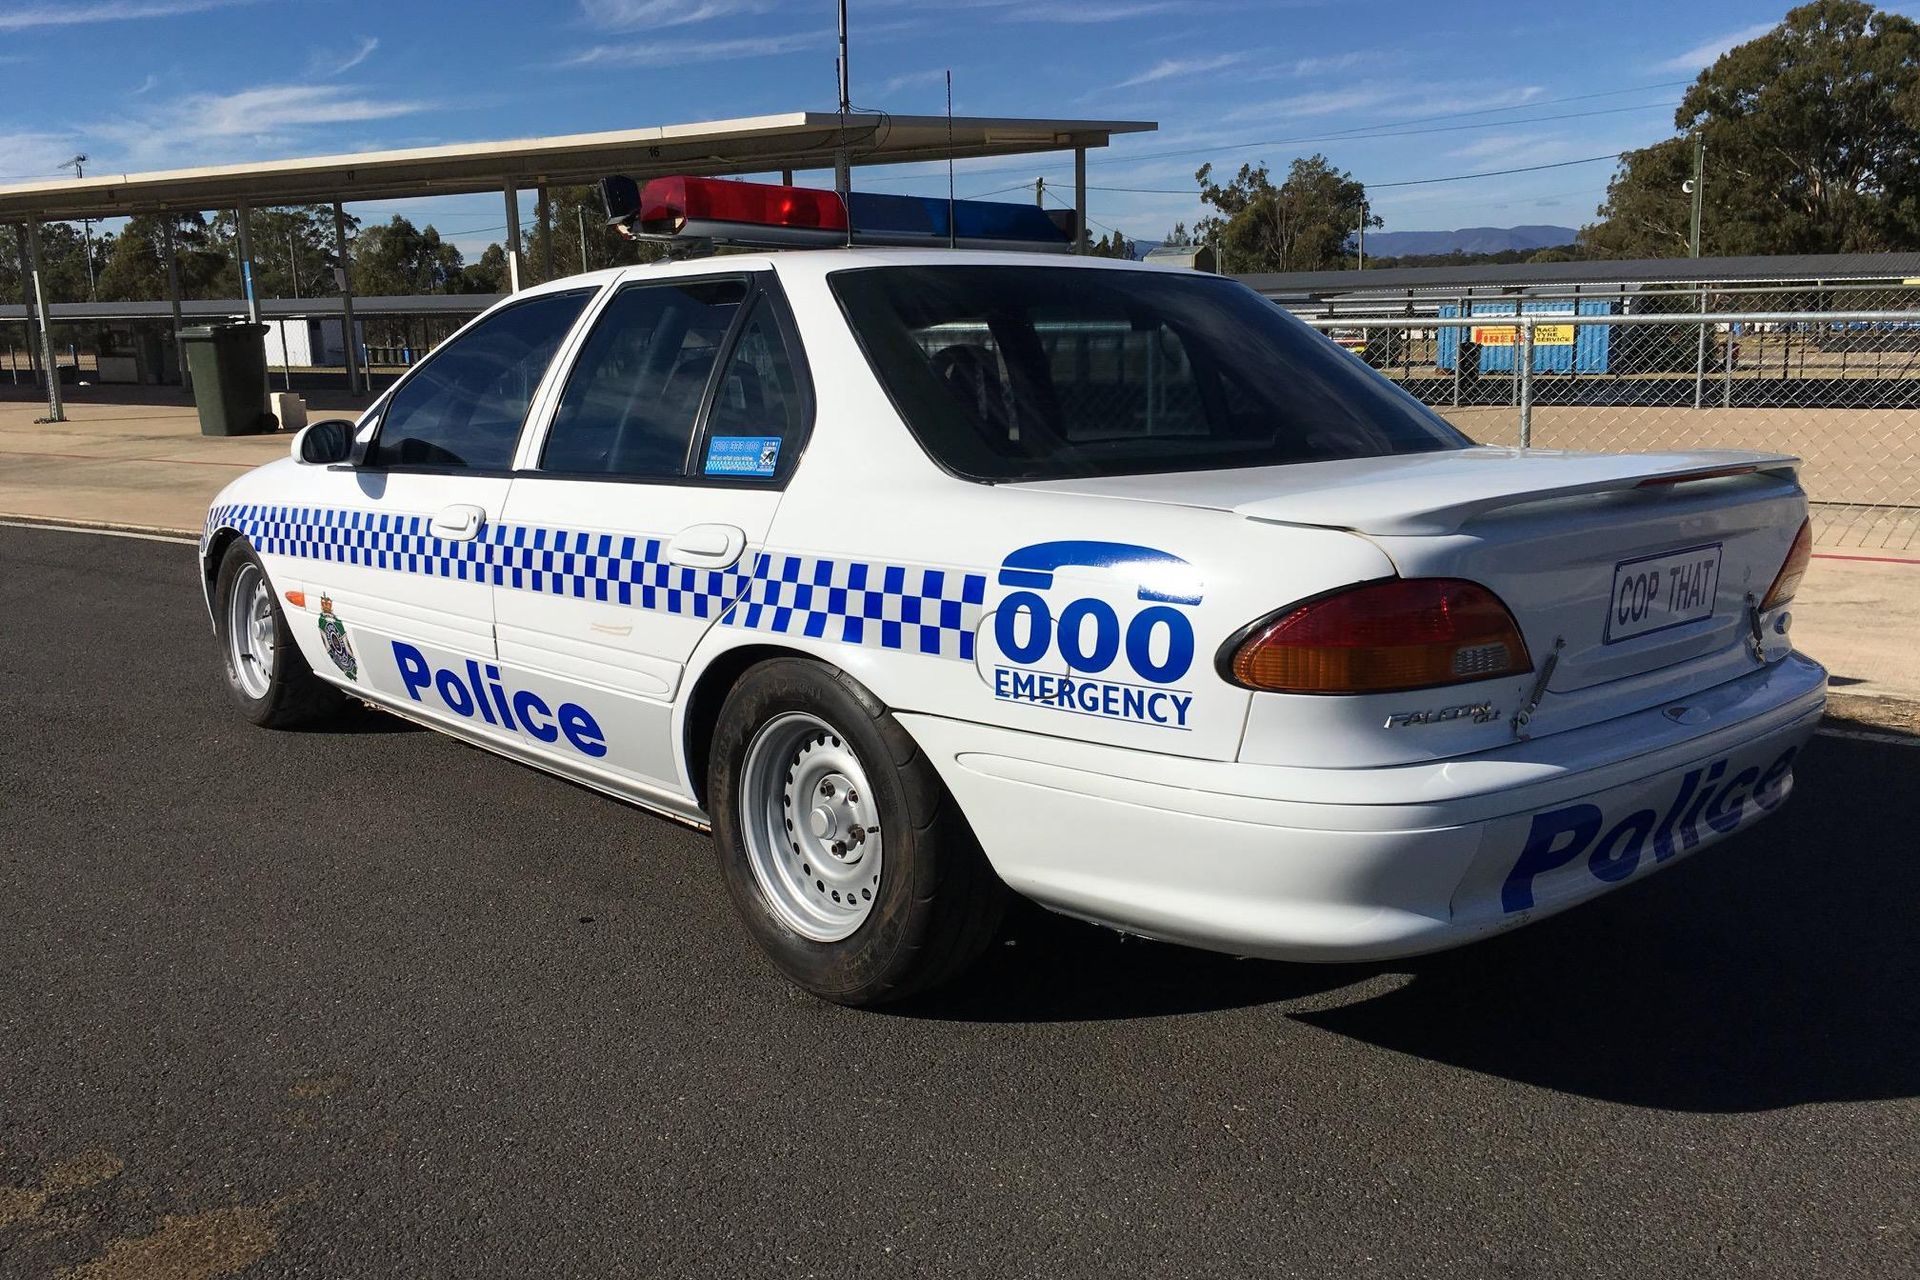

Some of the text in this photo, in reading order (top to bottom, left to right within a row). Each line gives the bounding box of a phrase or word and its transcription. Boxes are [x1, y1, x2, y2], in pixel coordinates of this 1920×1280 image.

[1475, 327, 1525, 344] PIREL
[1618, 560, 1714, 625] COP THAT
[995, 591, 1194, 684] 000
[391, 640, 607, 758] Police
[995, 669, 1192, 725] EMERGENCY
[1384, 701, 1492, 729] FALCON
[1501, 746, 1798, 913] Police
